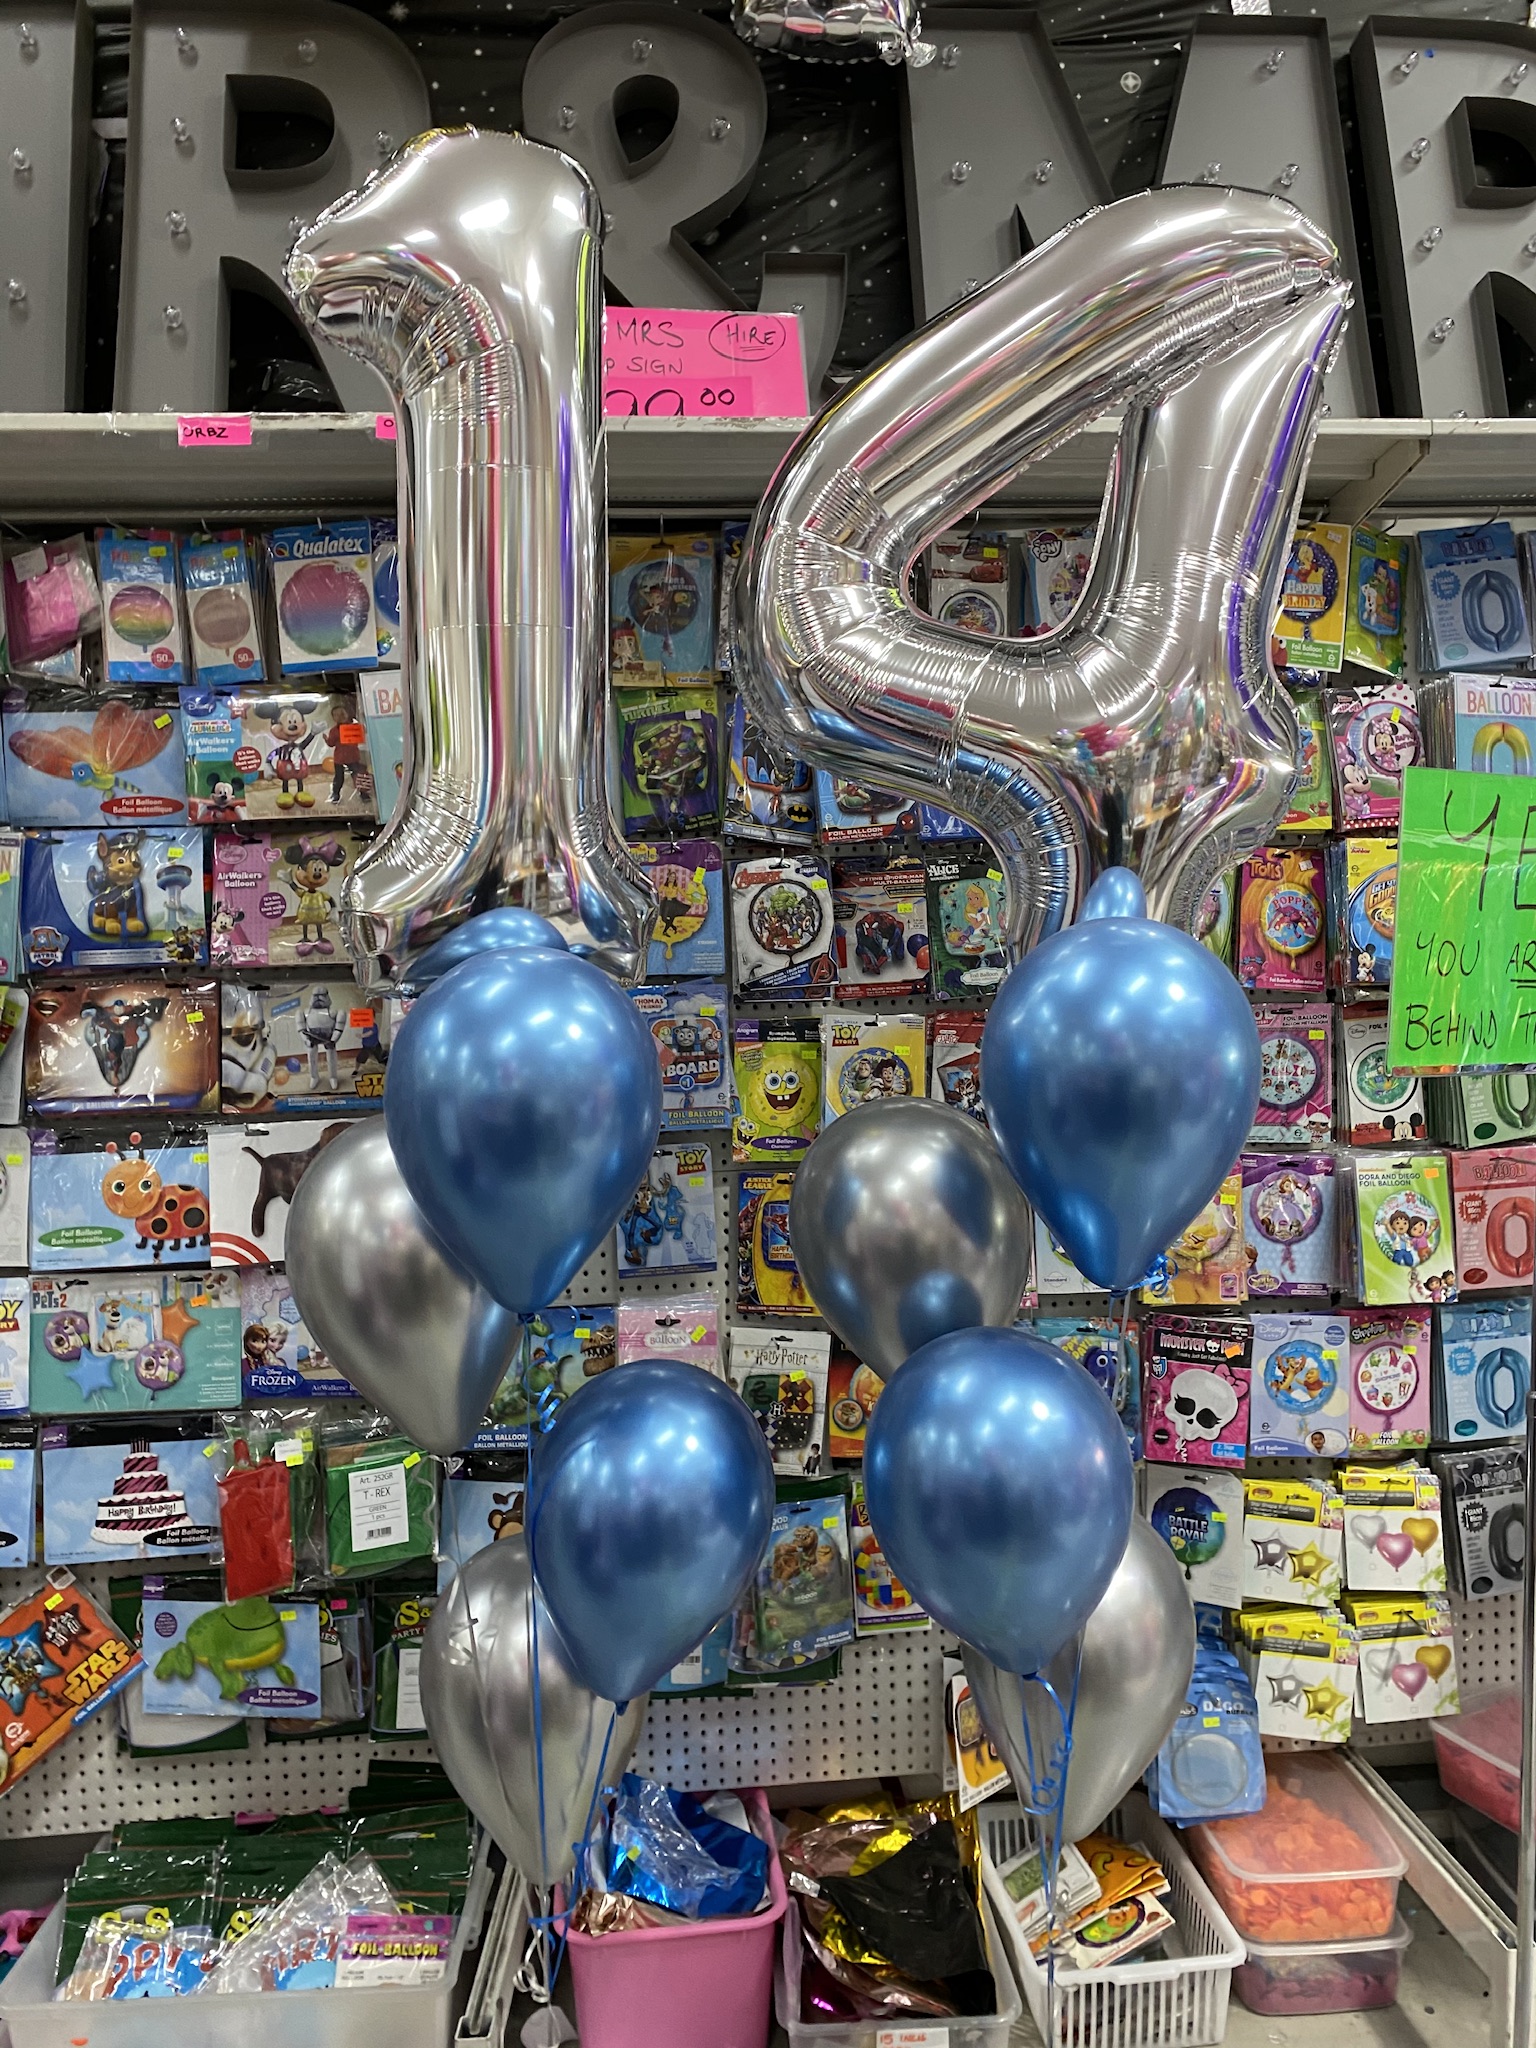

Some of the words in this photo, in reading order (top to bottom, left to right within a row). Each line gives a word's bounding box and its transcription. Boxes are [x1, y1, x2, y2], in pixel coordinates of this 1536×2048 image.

[617, 317, 684, 348] MRS
[726, 323, 776, 346] HIRE
[626, 356, 683, 375] SIGN
[700, 387, 735, 406] 00
[183, 427, 228, 439] ORBZ
[292, 537, 363, 558] Qualatex
[1287, 580, 1321, 594] Happy
[156, 653, 168, 662] 50
[237, 653, 248, 662] 50
[1467, 690, 1532, 714] BALLOON
[187, 737, 235, 746] AirWalkers
[196, 746, 228, 754] Balloon
[121, 798, 137, 807] Foil
[139, 797, 163, 807] Balloon
[112, 805, 138, 814] Ballon
[847, 826, 883, 834] BALLOON
[927, 864, 959, 877] ALICE
[1248, 859, 1281, 878] Trolls
[218, 872, 262, 880] AirWalkers
[224, 880, 256, 888] Balloon
[1416, 930, 1481, 978] YOU
[736, 1026, 759, 1036] Anagram
[832, 1024, 860, 1040] TOY
[1405, 1002, 1498, 1051] BEHIND
[1519, 1010, 1536, 1045] T
[662, 1060, 719, 1078] BOARD
[688, 1110, 725, 1118] BALLOON
[676, 1150, 707, 1165] TOY
[679, 1164, 704, 1173] STORY
[1473, 1162, 1527, 1181] BALLOON
[1358, 1173, 1380, 1181] DORA
[1378, 1179, 1411, 1187] BALLOON
[743, 1182, 773, 1190] LEAGUE
[75, 1229, 103, 1237] Balloon
[51, 1237, 75, 1246] Ballon
[75, 1235, 113, 1246] métallique
[1259, 1323, 1286, 1335] Disney
[1160, 1333, 1206, 1352] MONSTER
[755, 1349, 781, 1366] Harry
[781, 1348, 809, 1368] Potter
[251, 1375, 297, 1386] FROZEN
[311, 1384, 348, 1392] AirWalkers
[477, 1433, 493, 1441] FOIL
[494, 1432, 528, 1441] BALLOON
[1379, 1430, 1392, 1439] FOIL
[1372, 1437, 1399, 1446] BALLOON
[359, 1476, 371, 1484] Art.
[374, 1472, 394, 1481] 252GR
[1472, 1467, 1523, 1488] BALLOON
[363, 1491, 369, 1500] T
[375, 1486, 391, 1498] REX
[1168, 1515, 1208, 1532] BATTLE
[181, 1528, 210, 1536] Balloon
[1170, 1526, 1207, 1542] ROYAL
[391, 1627, 420, 1640] PARTY
[65, 1639, 120, 1686] STAR
[63, 1641, 131, 1705] WARS
[257, 1689, 270, 1697] Foil
[74, 1711, 87, 1722] FOIL
[86, 1689, 112, 1711] BALLOON
[249, 1697, 271, 1705] Ballon
[352, 1941, 379, 1956] FOIL
[383, 1942, 439, 1958] BALLOON
